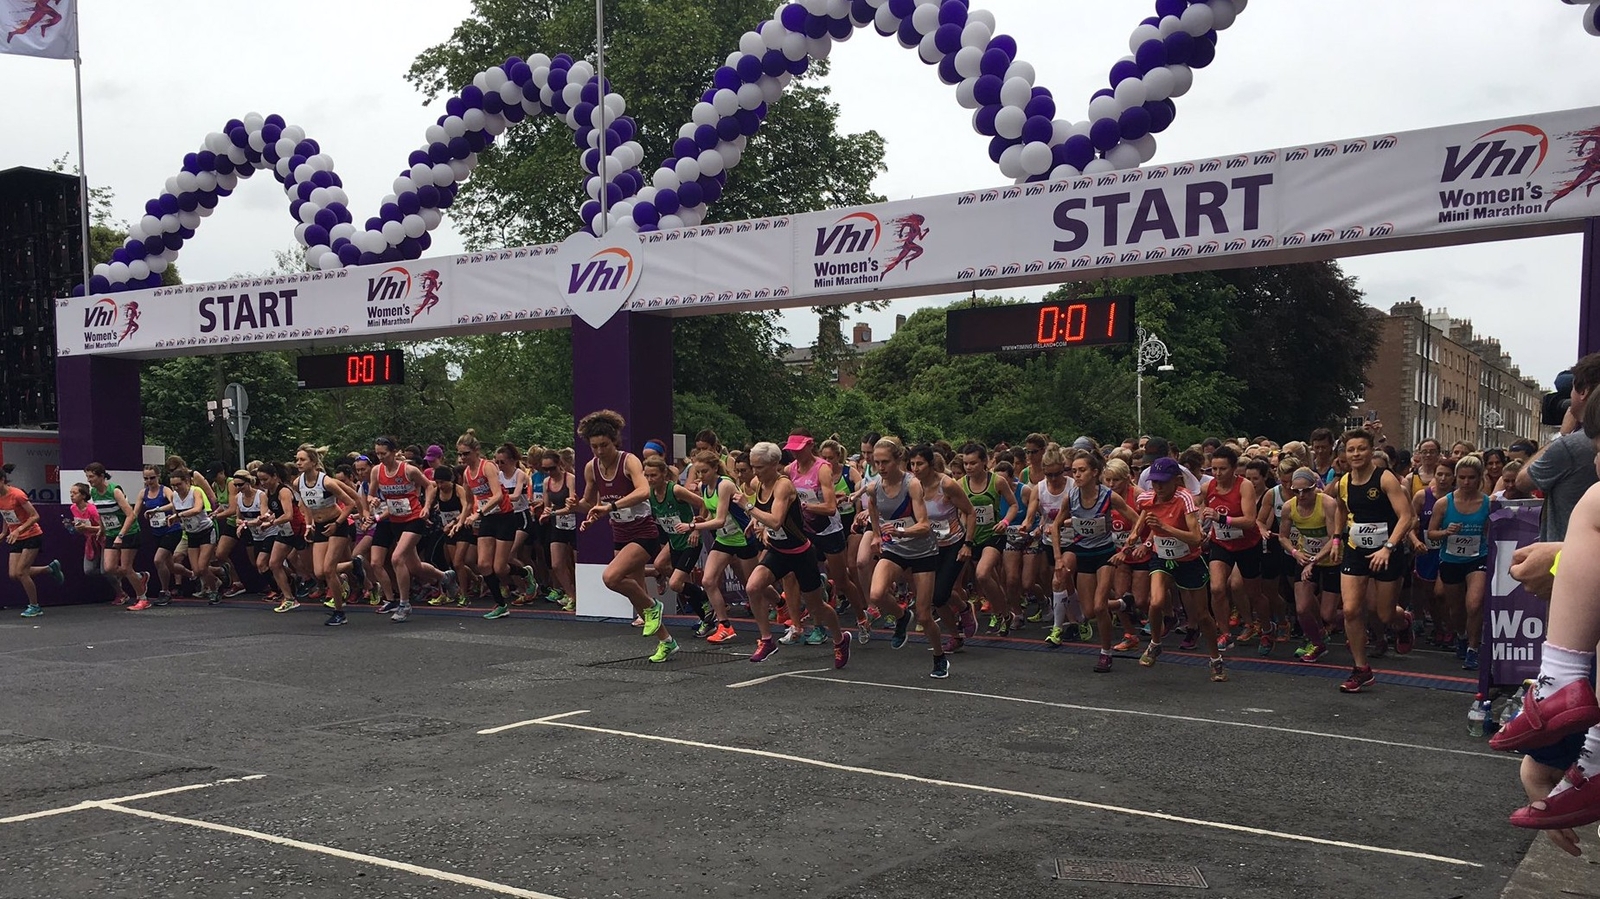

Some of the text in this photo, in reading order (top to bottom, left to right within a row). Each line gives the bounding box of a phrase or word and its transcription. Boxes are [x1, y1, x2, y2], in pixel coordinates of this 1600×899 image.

[1285, 135, 1397, 161] Vhi Vhi Vhi Vhi
[1440, 138, 1542, 184] Vhi
[958, 150, 1276, 205] Vhi Vhi Vhi Vhi Vhi Vhi Vhi Vhi Vhi Vhi Vhi Vhi Vhi
[1439, 181, 1544, 210] Women's
[1052, 173, 1274, 253] START
[1438, 203, 1542, 224] Mini Marathon
[814, 222, 874, 258] Vhi
[1282, 222, 1394, 246] Vhi Vhi Vhi Vhi
[814, 257, 879, 278] Women's
[956, 234, 1274, 279] Vhi Vhi Vhi Vhi Vhi Vhi Vhi Vhi Vhi Vhi Vhi Vhi Vhi
[367, 272, 408, 302] Vhi
[567, 259, 628, 295] Vhi
[814, 274, 879, 289] Mini Marathon
[84, 302, 116, 329] Vhi
[200, 289, 298, 333] START
[367, 303, 410, 319] Women's
[367, 317, 411, 328] Mini Marathon
[84, 331, 118, 342] Women's
[1081, 528, 1094, 536] 134
[1358, 524, 1378, 534] Vhi
[1161, 538, 1178, 547] Vhi
[1361, 537, 1374, 546] 56
[1455, 537, 1474, 545] Vhi
[1165, 549, 1175, 558] 81
